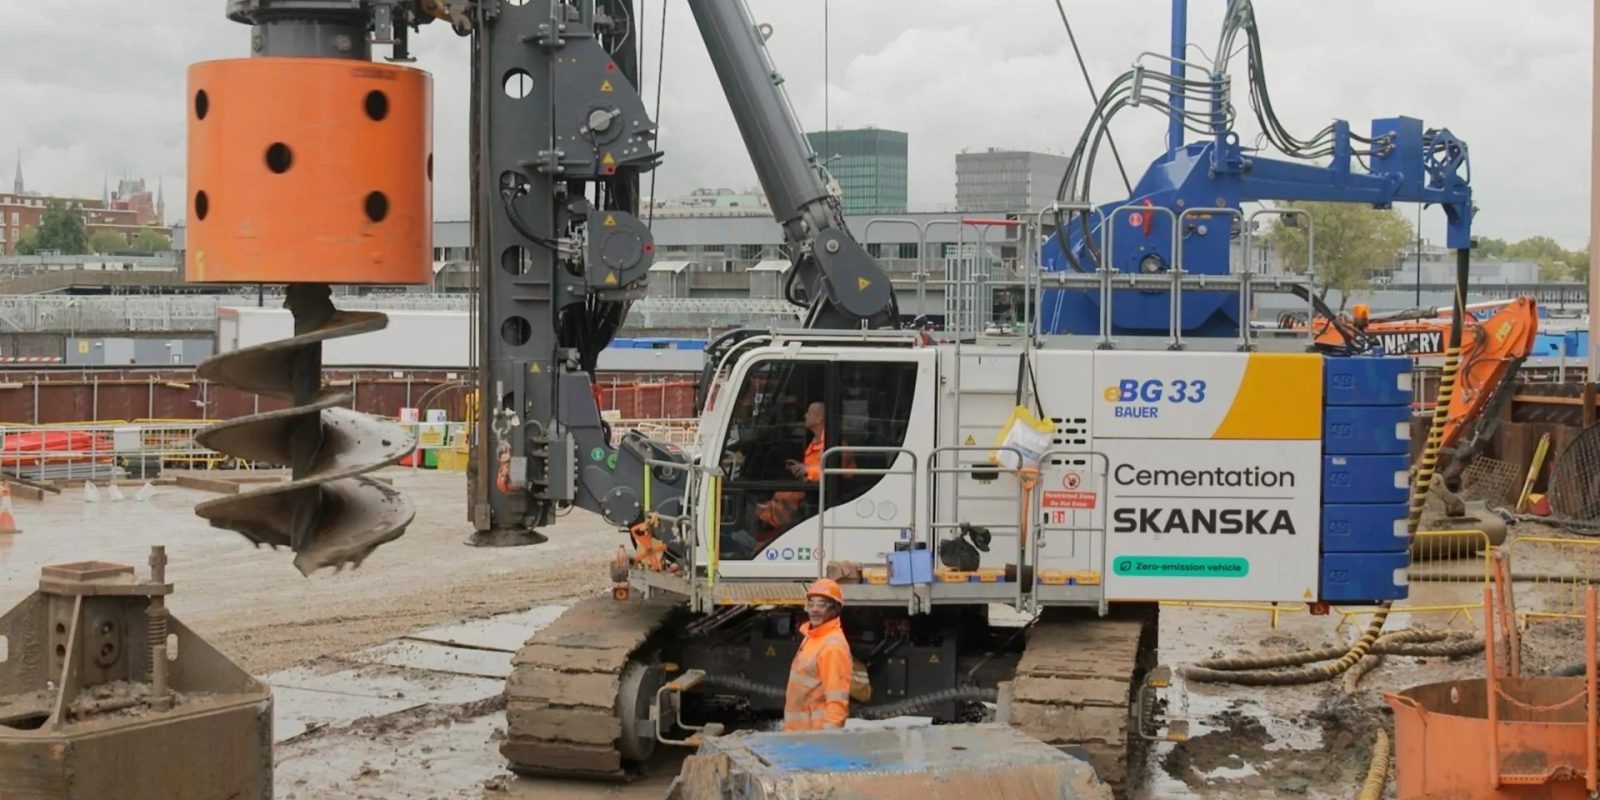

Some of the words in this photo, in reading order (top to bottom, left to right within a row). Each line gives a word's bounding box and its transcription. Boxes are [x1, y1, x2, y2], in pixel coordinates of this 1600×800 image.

[1103, 378, 1164, 402] eBG
[1167, 379, 1206, 403] 33
[1114, 406, 1158, 418] BAUER
[1113, 463, 1295, 487] Cementation
[1113, 508, 1297, 535] SKANSKA
[1136, 562, 1205, 572] Zero-emission
[1208, 563, 1242, 572] vehicle
